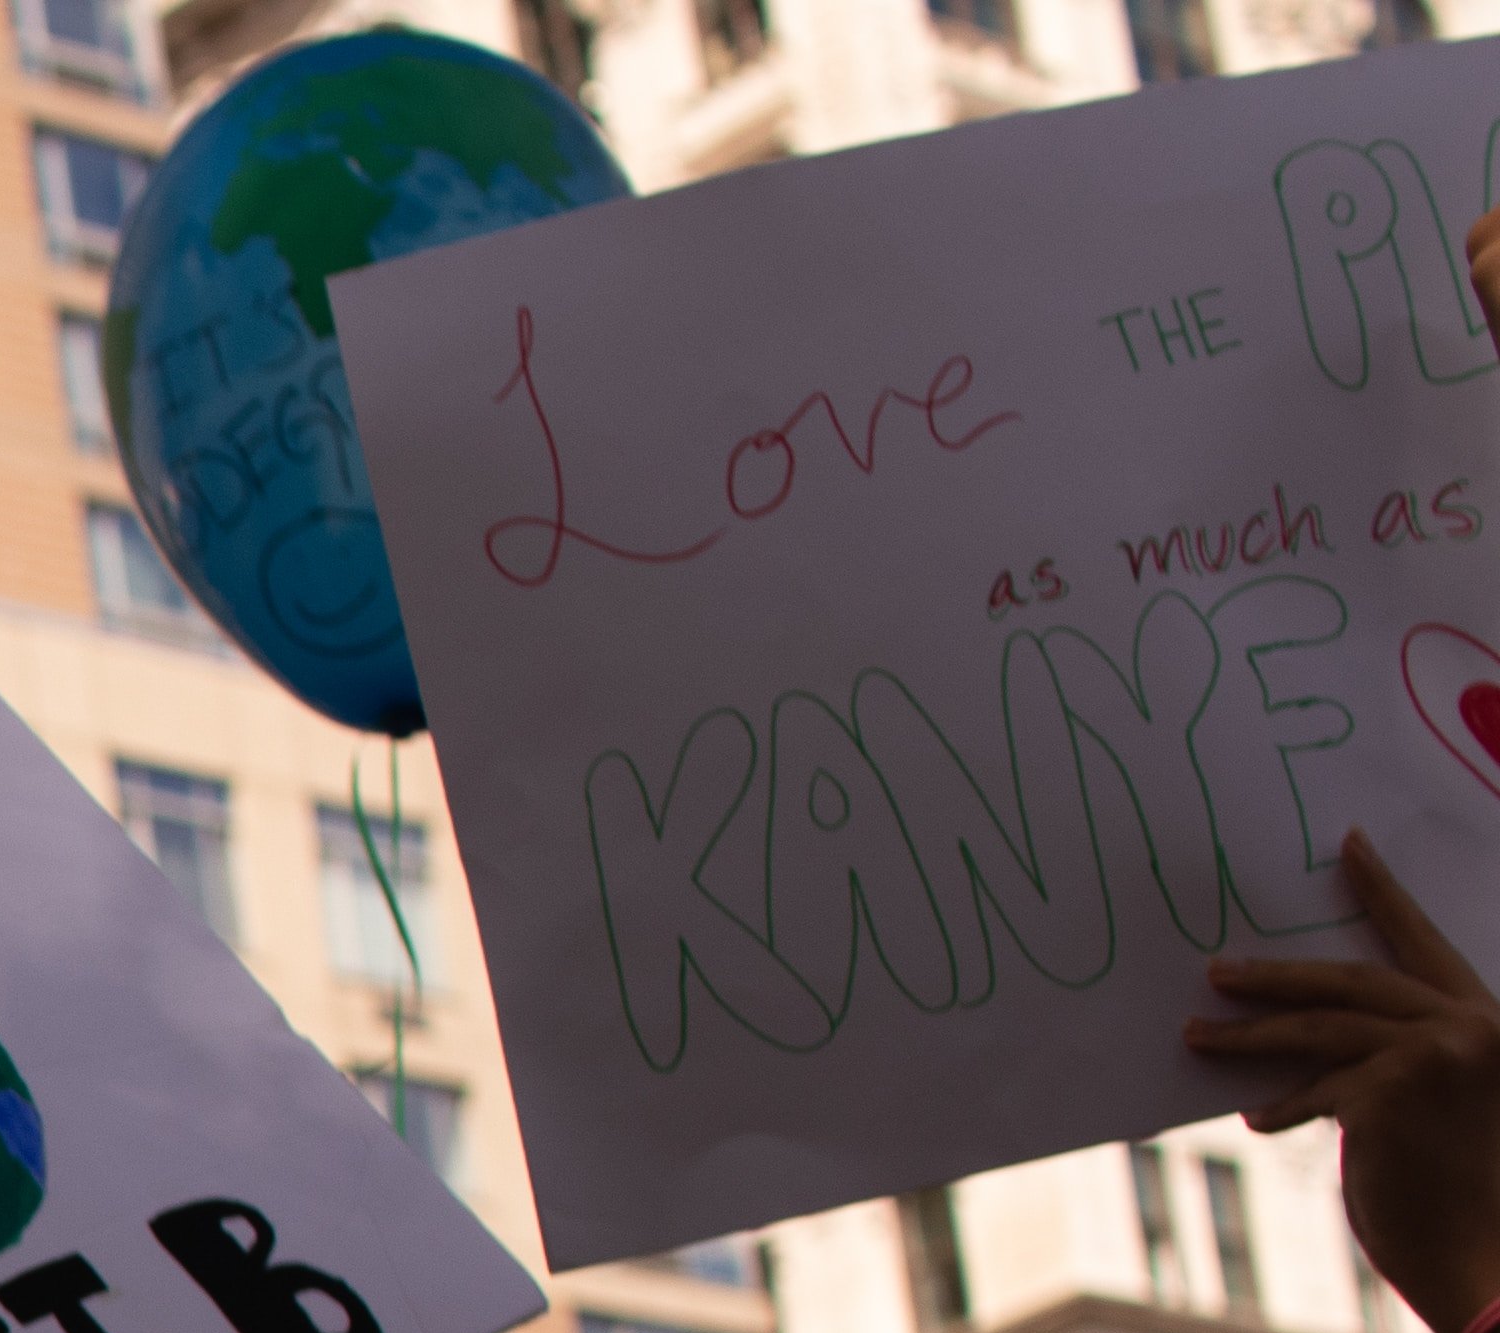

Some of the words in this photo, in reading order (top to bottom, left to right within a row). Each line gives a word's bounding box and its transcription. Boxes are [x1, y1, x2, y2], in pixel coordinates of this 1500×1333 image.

[485, 305, 1021, 587] Love
[1103, 287, 1242, 372] THE
[1273, 138, 1500, 392] PL
[988, 557, 1070, 620] as
[1116, 485, 1336, 583] much
[1373, 478, 1481, 548] as
[585, 576, 1370, 1073] KANYE
